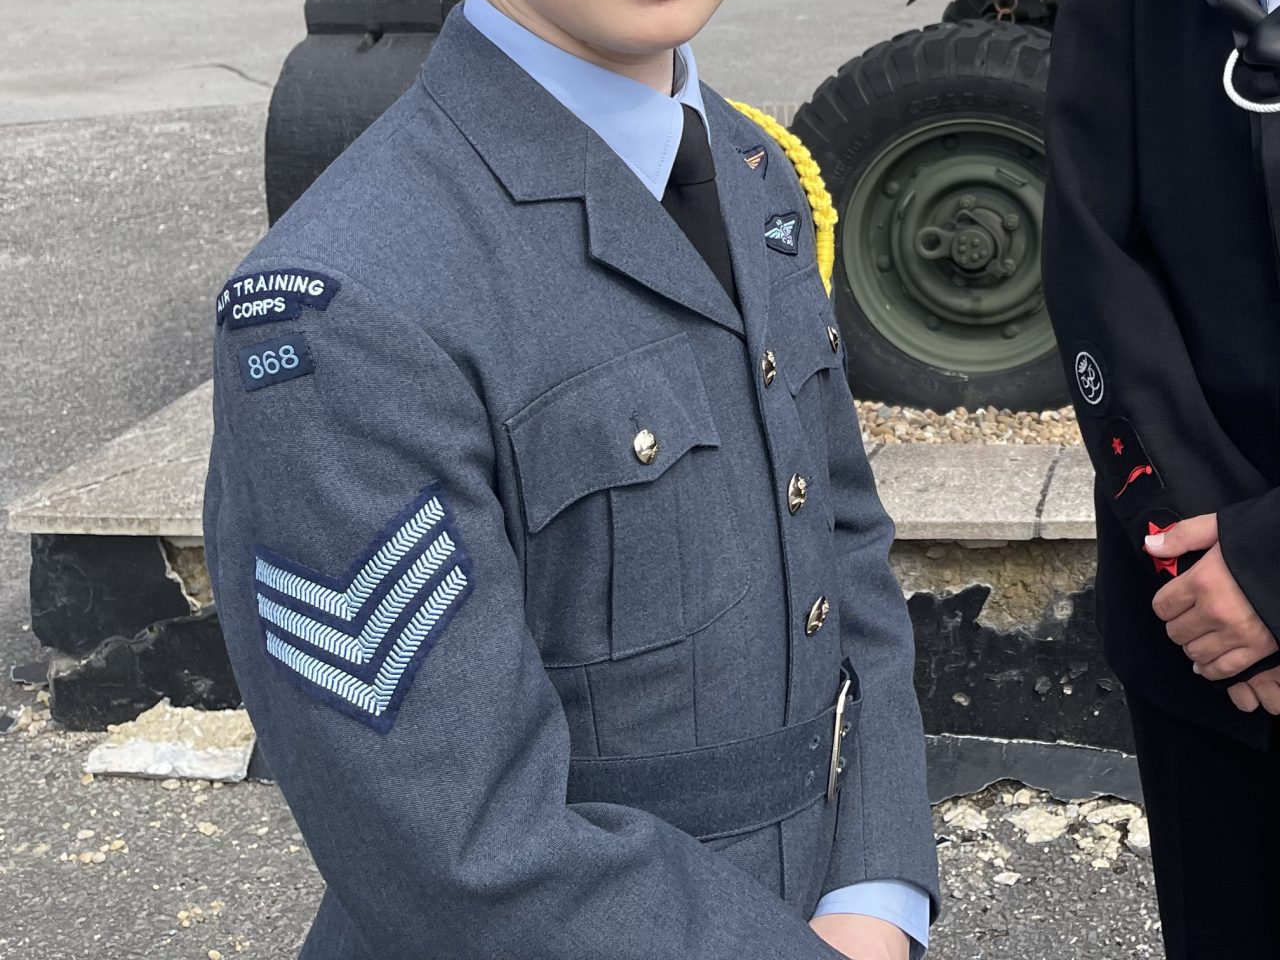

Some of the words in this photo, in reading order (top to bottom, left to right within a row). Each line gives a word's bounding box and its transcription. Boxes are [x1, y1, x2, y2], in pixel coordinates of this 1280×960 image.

[217, 289, 231, 313] AIR
[233, 274, 325, 297] TRAINING
[232, 296, 286, 319] CORPS
[247, 344, 299, 379] 868
